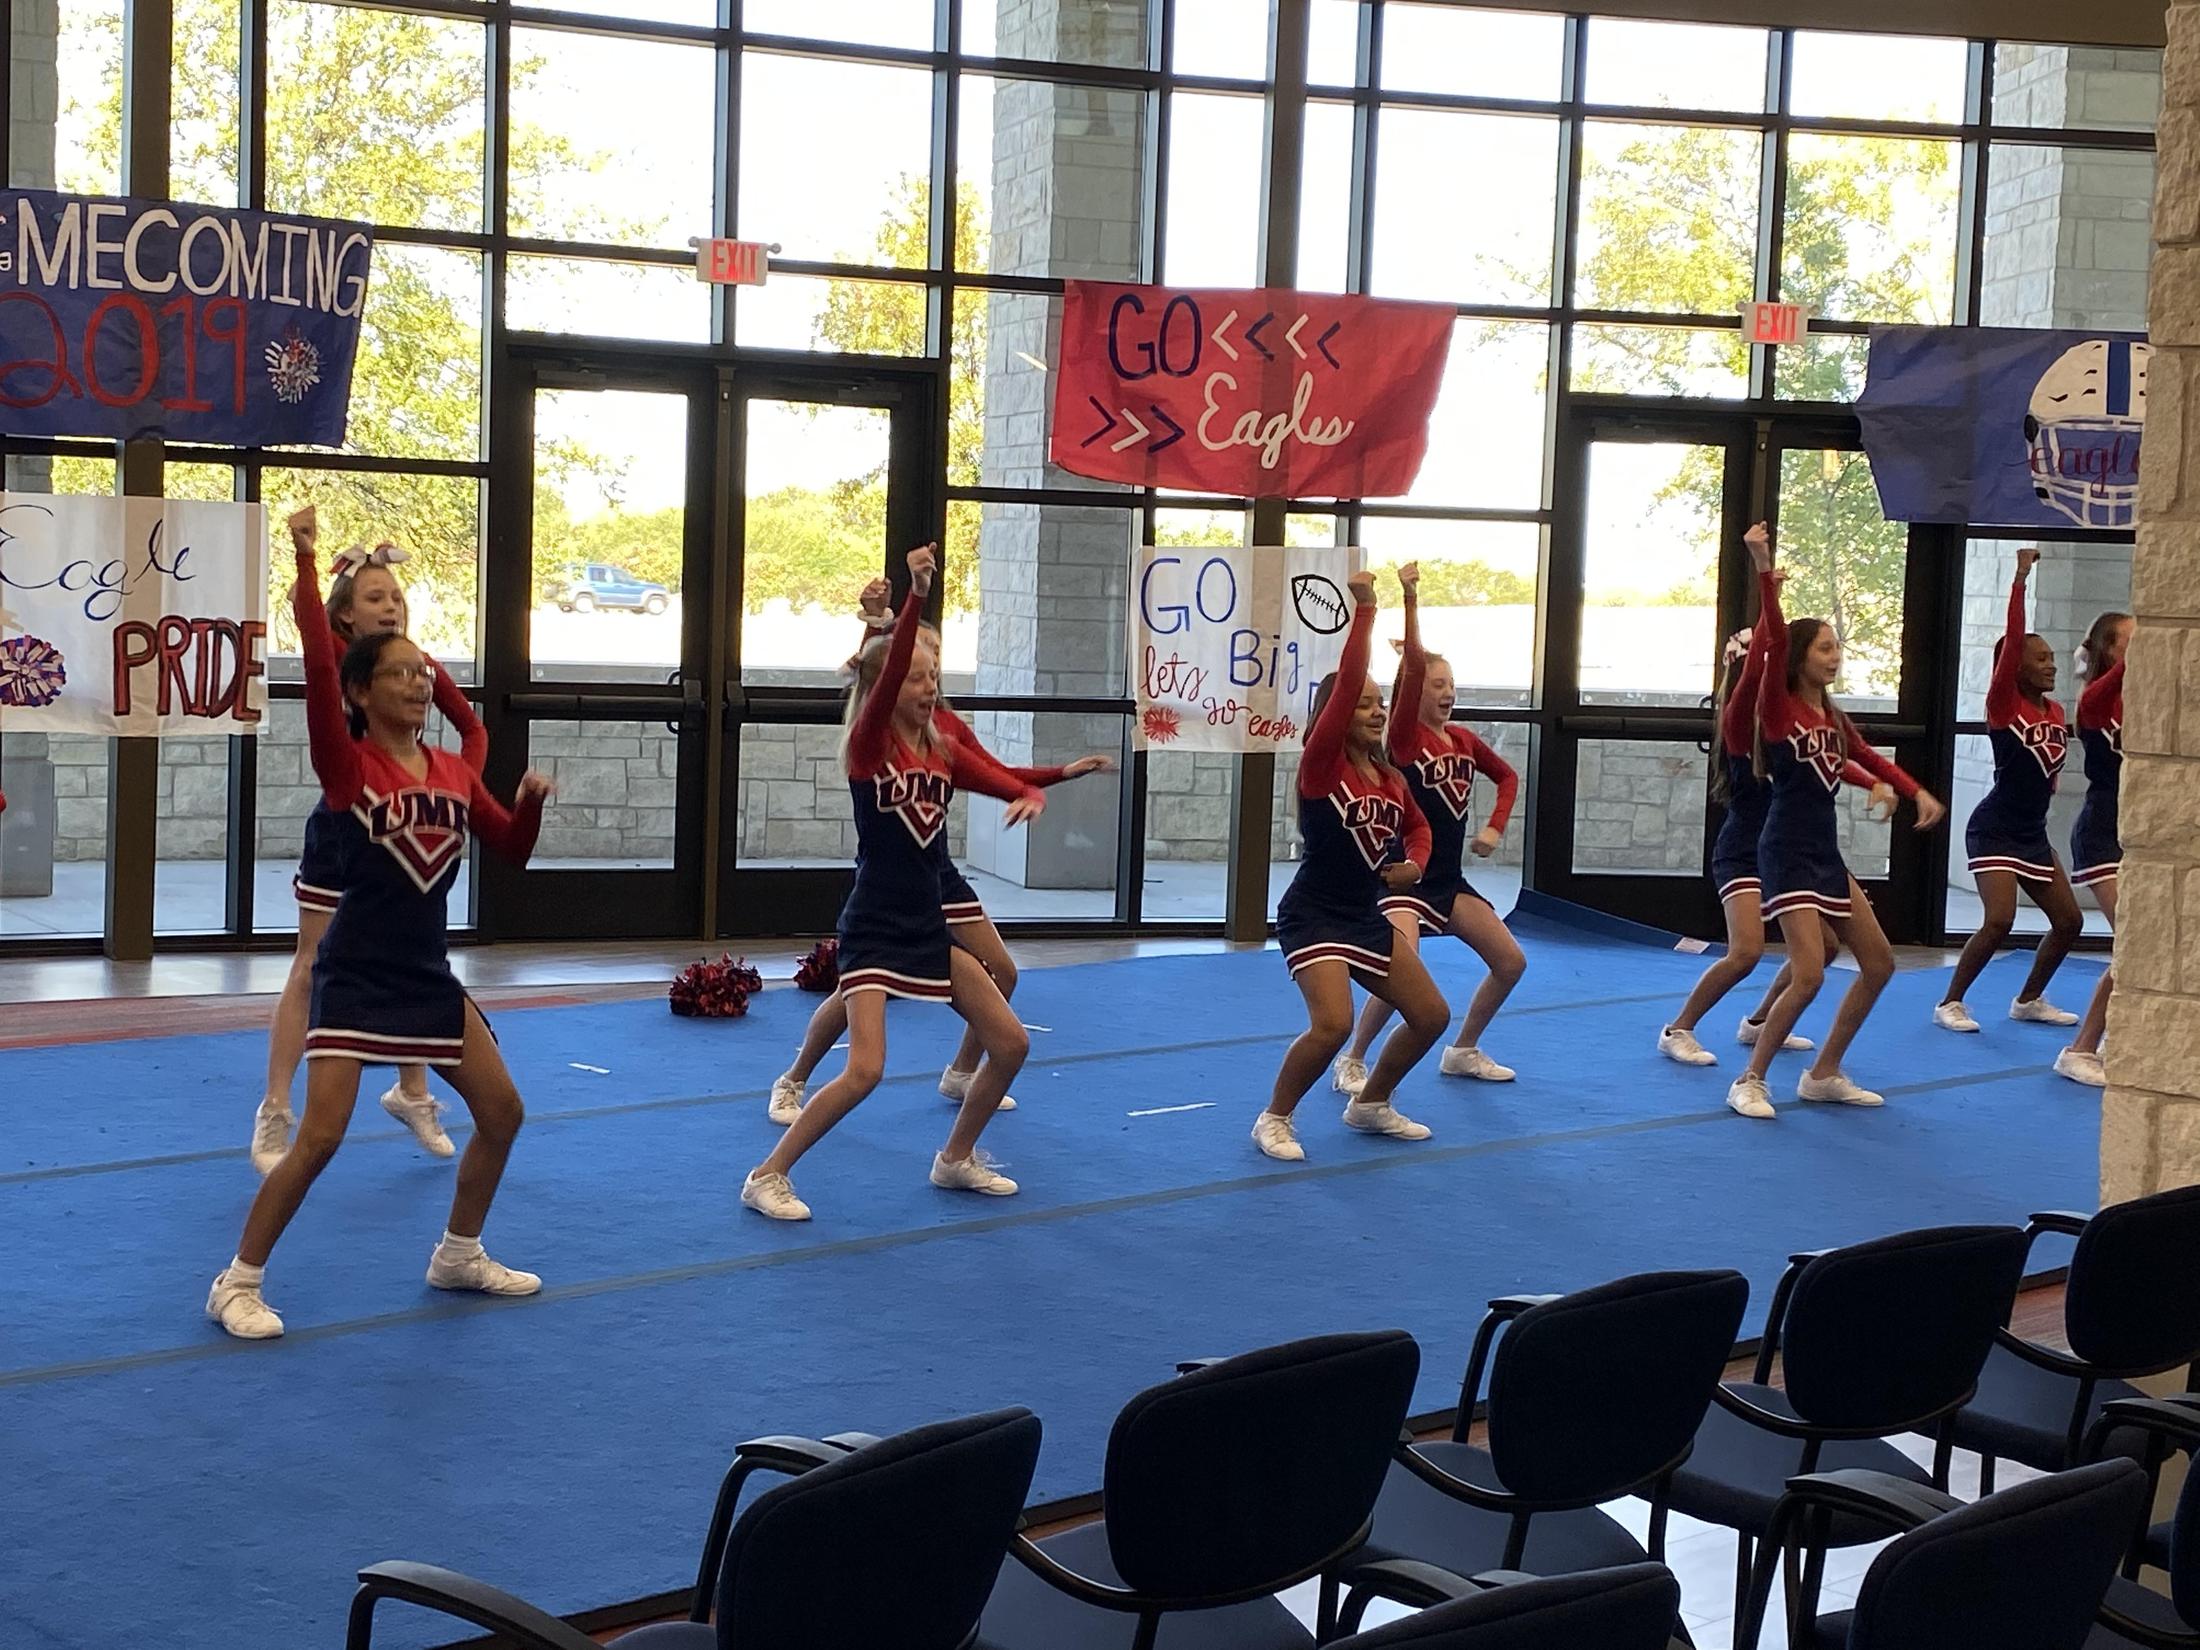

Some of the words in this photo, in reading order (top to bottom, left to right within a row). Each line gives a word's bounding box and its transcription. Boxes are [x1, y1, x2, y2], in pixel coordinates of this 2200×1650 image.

[17, 198, 368, 318] MECOMING
[711, 240, 759, 282] EXIT
[0, 291, 248, 416] 2019
[1107, 293, 1203, 381] GO
[1755, 303, 1800, 341] EXIT
[1197, 370, 1354, 469] Eagles
[0, 504, 197, 622] Eagle
[1141, 557, 1236, 634] GO
[113, 615, 267, 722] PRIDE
[1140, 645, 1209, 701] lets
[1229, 629, 1304, 694] Big
[1202, 696, 1253, 725] go
[1248, 714, 1298, 741] eagles
